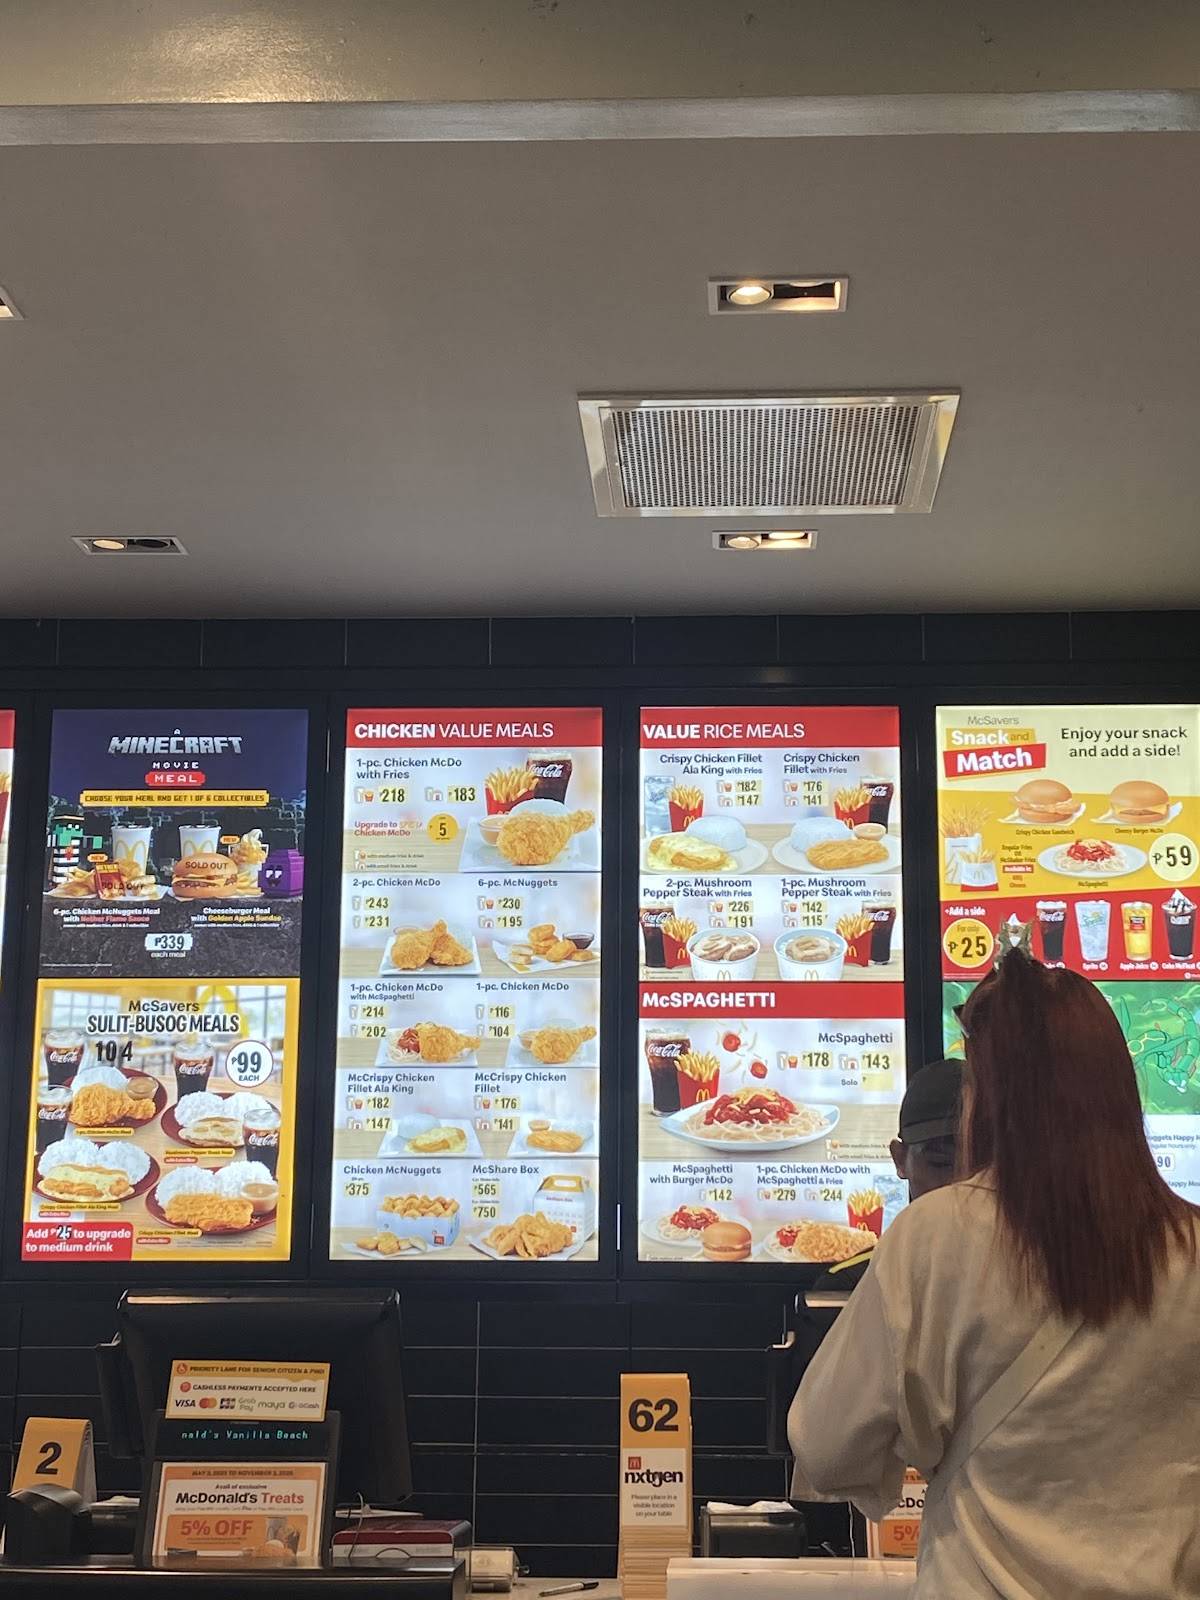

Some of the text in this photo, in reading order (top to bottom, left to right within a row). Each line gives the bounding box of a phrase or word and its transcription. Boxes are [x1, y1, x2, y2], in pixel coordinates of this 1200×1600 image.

[968, 716, 1019, 726] McSavers
[355, 723, 553, 738] CHICKEN VALUE MEALS
[643, 724, 805, 738] VALUE RICE MEALS
[1061, 727, 1188, 742] Enjoy your snack
[952, 730, 1029, 745] Snack and
[108, 737, 242, 754] MINECRAFT
[1069, 744, 1181, 758] and add a side!
[357, 758, 462, 769] 1-pc. Chicken McDo
[660, 754, 762, 765] Crispy Chicken Fillet
[784, 753, 859, 764] Crispy Chicken
[957, 748, 1032, 773] Match
[357, 770, 410, 779] with Fries
[683, 766, 699, 775] Ala
[701, 766, 724, 776] King
[155, 774, 197, 783] MEAL
[353, 879, 375, 888] 2-pc.
[415, 879, 441, 887] McDo
[478, 879, 558, 889] 6-pc. McNuggets
[666, 878, 752, 888] 2-pc. Mushroom
[643, 888, 681, 899] Pepper
[683, 888, 713, 897] Steak
[102, 908, 142, 916] McNuggets
[970, 907, 985, 916] side
[476, 982, 569, 992] 1-pc. Chicken McDo
[642, 992, 776, 1008] McSPAGHETTI
[129, 1000, 200, 1013] McSavers
[87, 1015, 239, 1033] SULIT-BUSOG MEALS
[818, 1033, 893, 1045] McSpaghetti
[348, 1073, 435, 1083] McCrispy Chicken
[348, 1085, 413, 1095] Fillet Ala King
[344, 1166, 441, 1176] Chicken McNuggets
[472, 1165, 539, 1174] McShare Box
[673, 1165, 733, 1176] McSpaghetti
[757, 1165, 870, 1176] 1-pc. Chicken McDo with
[650, 1175, 733, 1186] with Burger McDo
[757, 1175, 817, 1186] McSpaghetti
[825, 1177, 843, 1185] Fries
[26, 1229, 48, 1238] Add
[73, 1229, 84, 1239] to
[87, 1229, 131, 1241] upgrade
[26, 1242, 113, 1252] to medium drink
[628, 1398, 679, 1432] 62
[227, 1430, 270, 1439] Vanilla
[35, 1441, 62, 1475] 2
[625, 1469, 683, 1487] nxtgen
[176, 1492, 304, 1504] McDonald's Treats
[181, 1519, 253, 1536] 5% OFF
